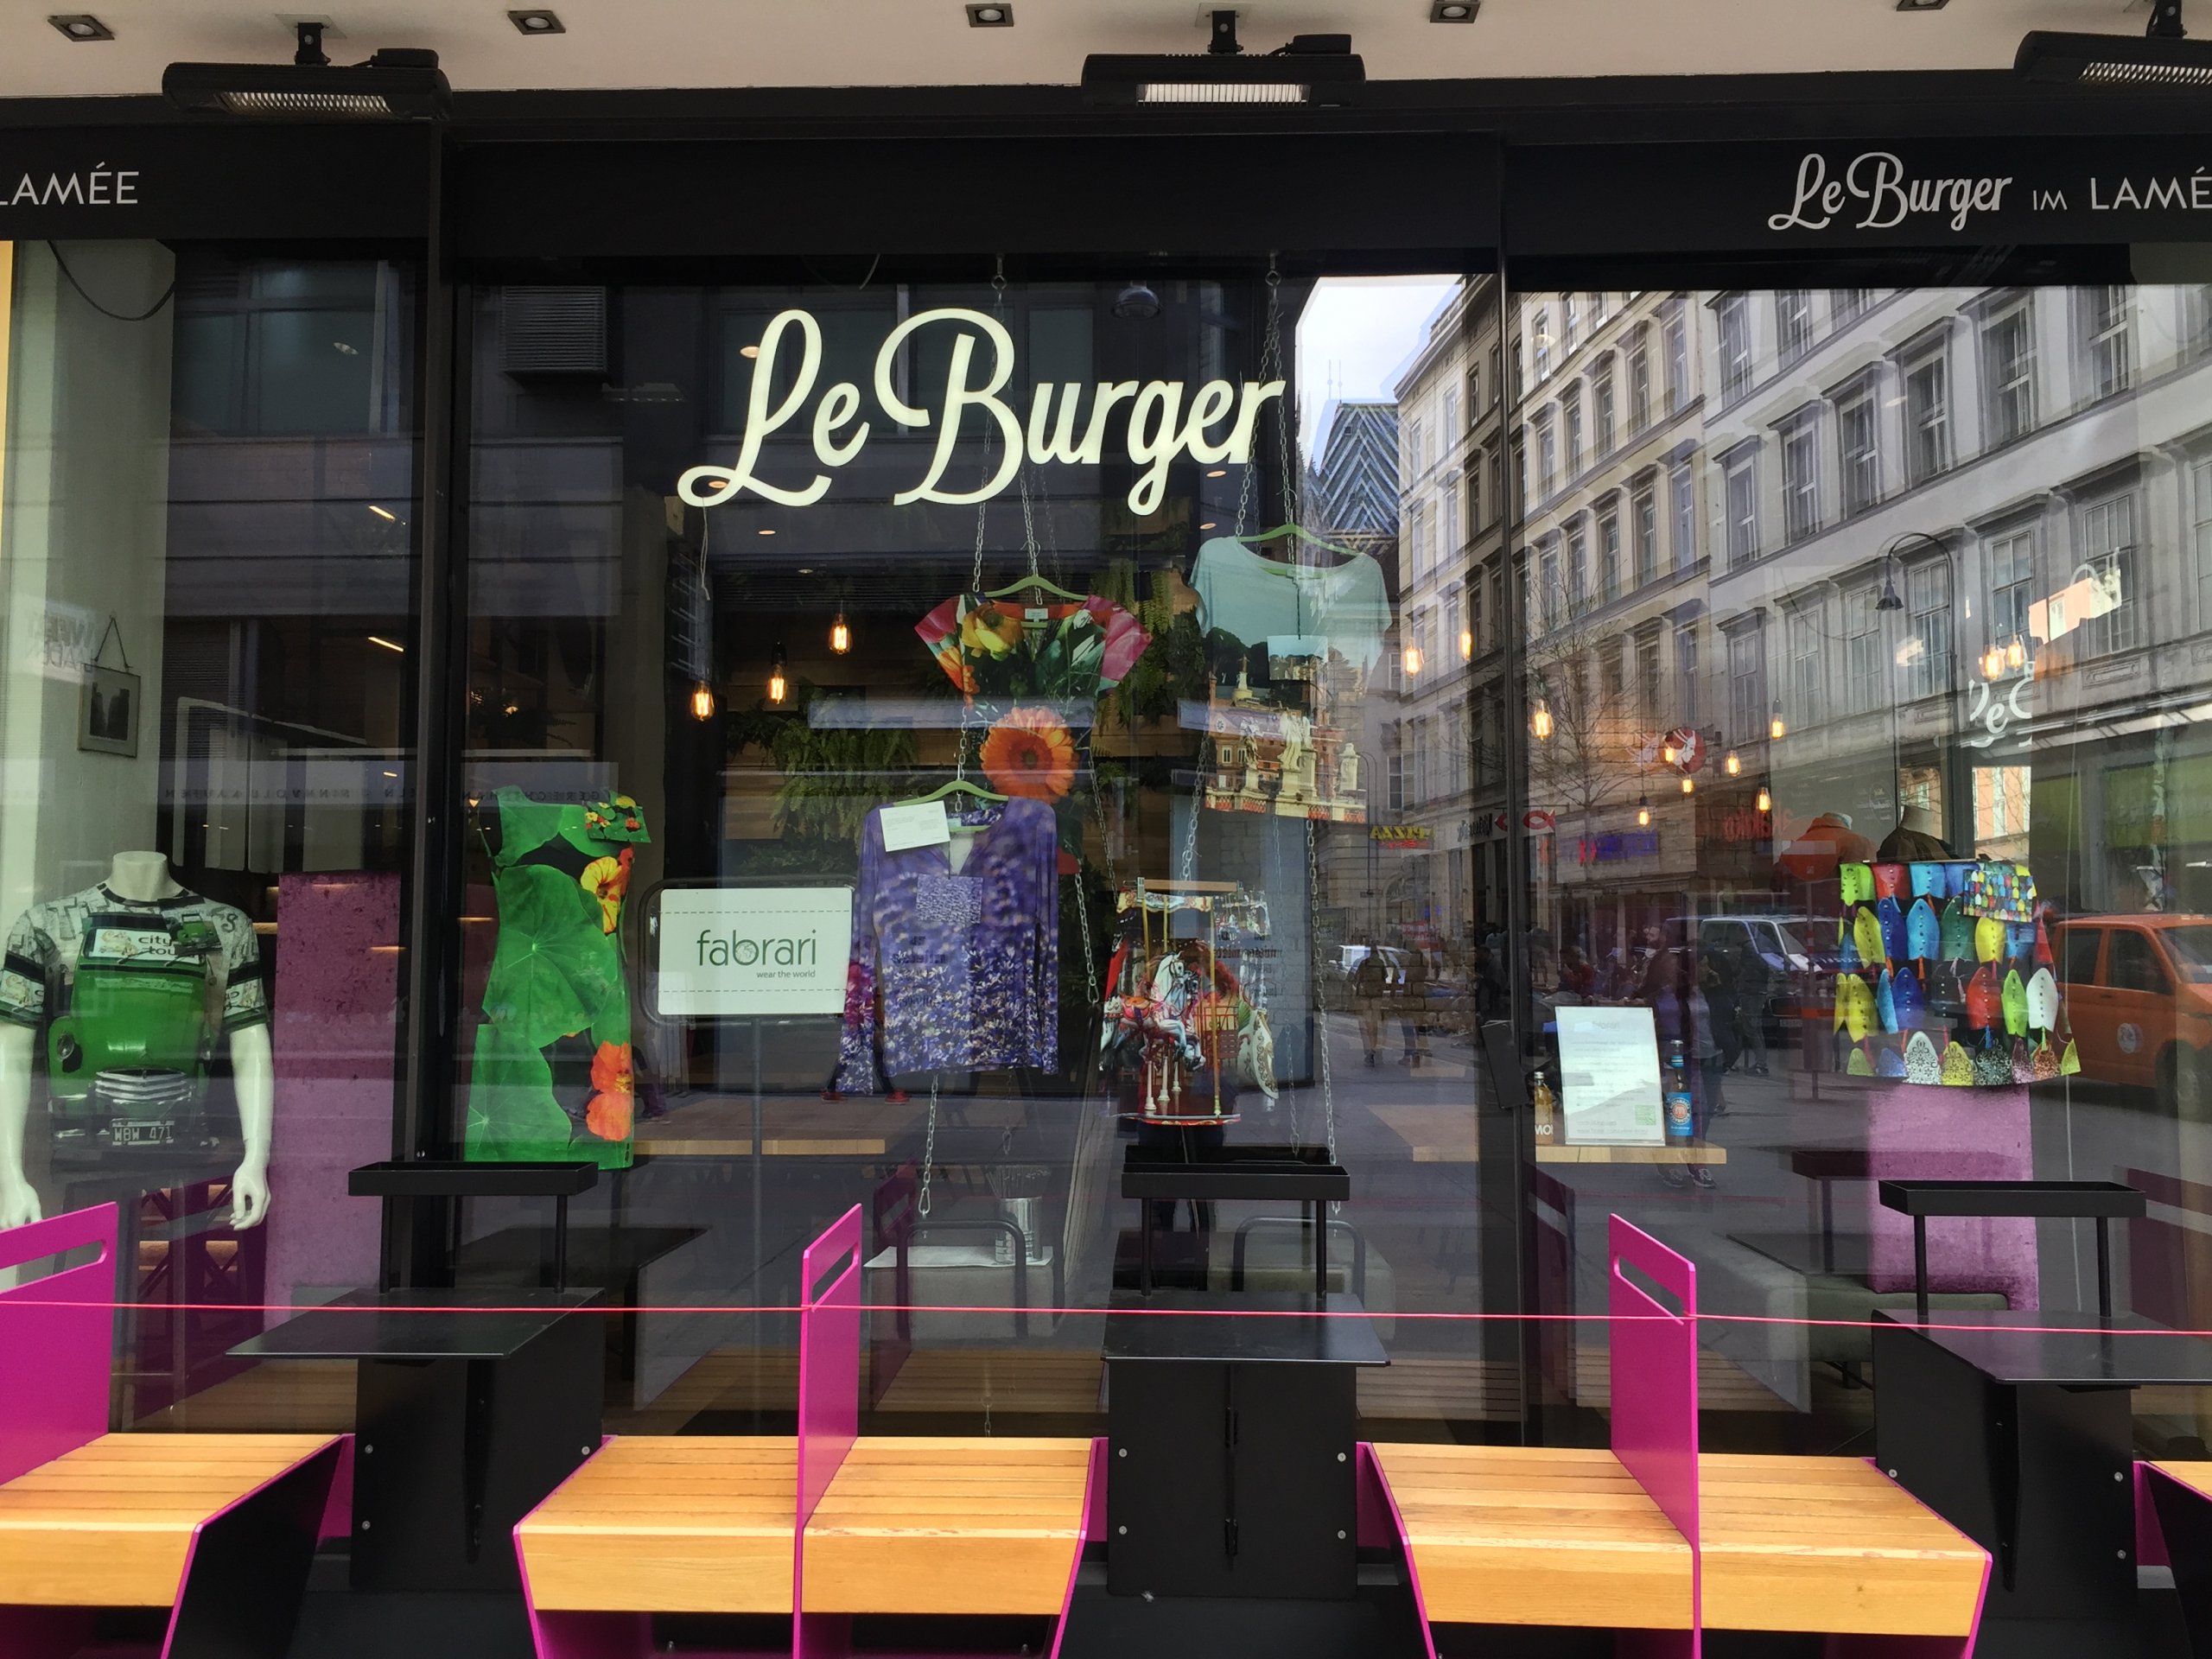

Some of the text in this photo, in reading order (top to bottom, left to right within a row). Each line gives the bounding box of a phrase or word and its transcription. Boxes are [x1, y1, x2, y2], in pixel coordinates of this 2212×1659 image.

[2033, 189, 2068, 211] IM
[138, 935, 172, 944] city
[147, 946, 176, 956] tou
[696, 929, 817, 966] fabrari
[114, 1126, 171, 1141] WBW 471
